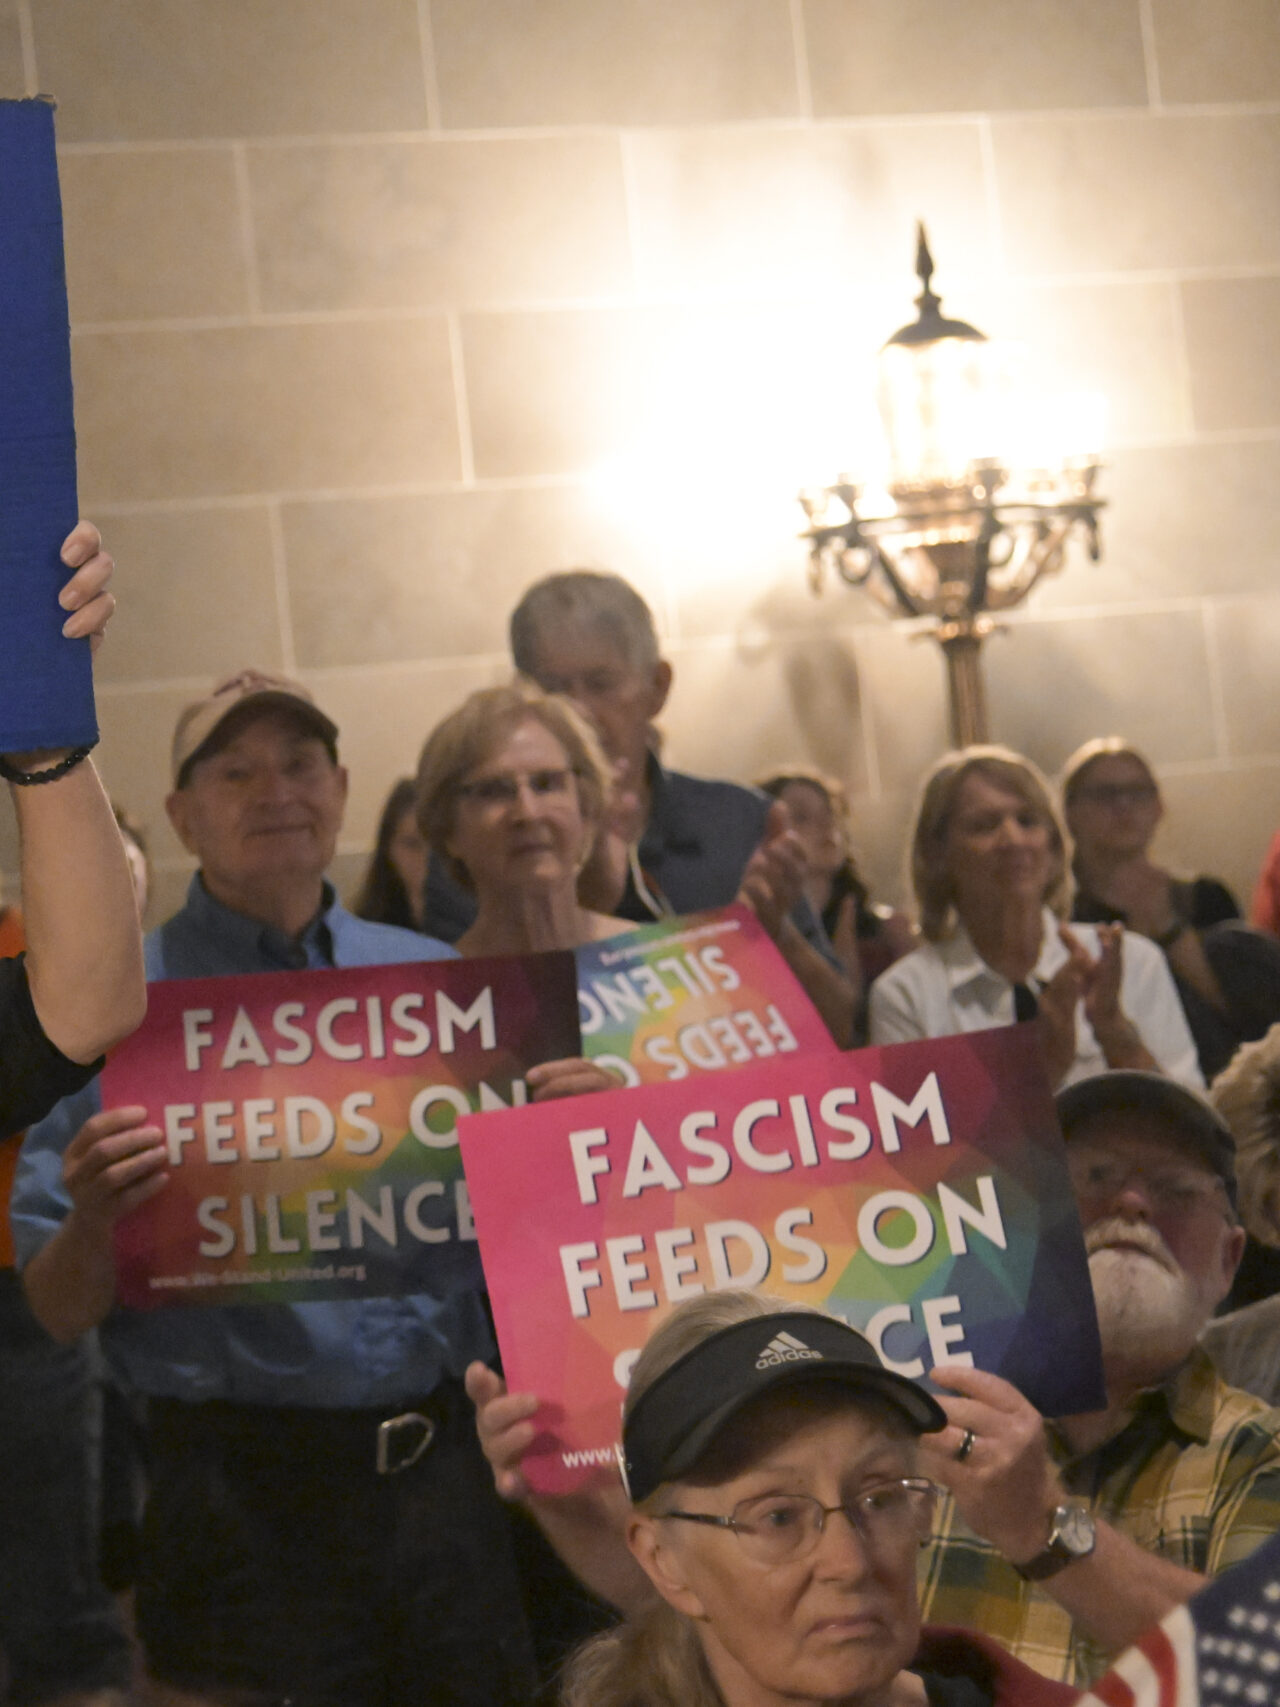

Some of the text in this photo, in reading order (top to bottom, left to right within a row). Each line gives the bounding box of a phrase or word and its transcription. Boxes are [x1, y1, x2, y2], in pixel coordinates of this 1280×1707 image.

[182, 985, 496, 1072] FASCISM
[577, 945, 741, 1035] SILENC
[645, 1003, 799, 1081] FEEDS
[163, 1091, 382, 1168] FEEDS
[568, 1071, 951, 1205] FASCISM
[559, 1176, 1008, 1319] FEEDS ON
[755, 1348, 823, 1370] adidas
